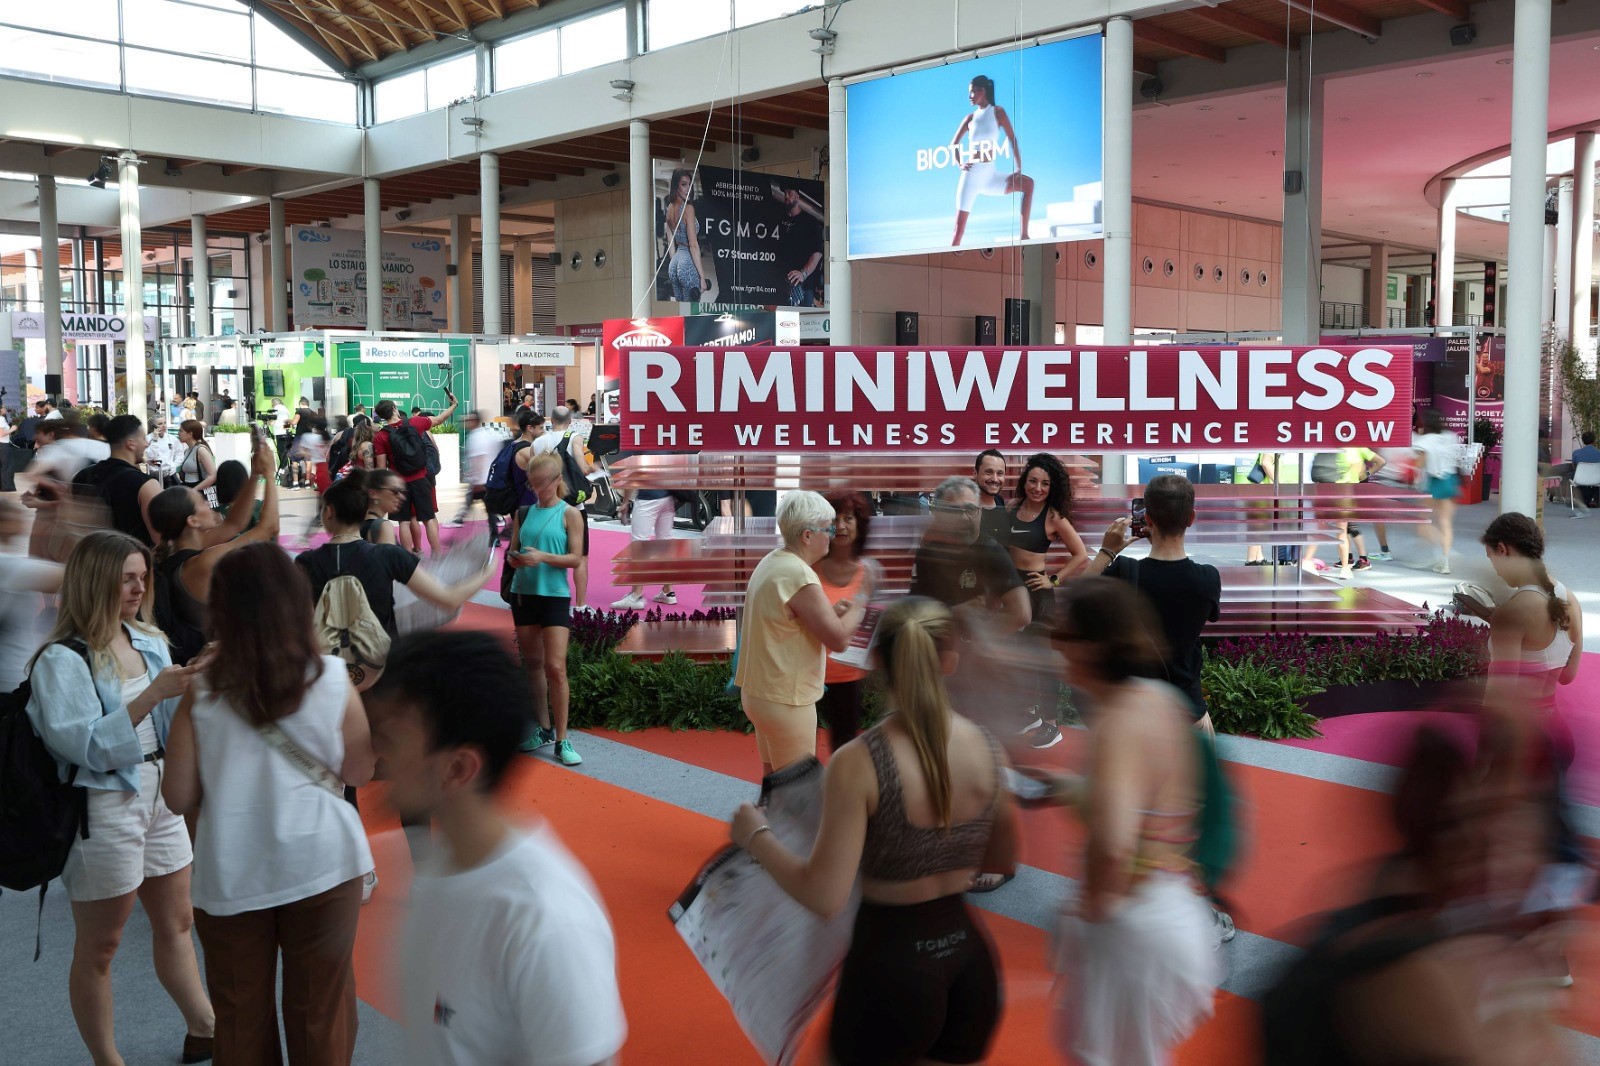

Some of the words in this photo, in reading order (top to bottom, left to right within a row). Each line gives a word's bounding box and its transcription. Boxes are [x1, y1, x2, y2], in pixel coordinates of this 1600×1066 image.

[916, 139, 1010, 171] BIOTHERM
[705, 217, 780, 240] FGM04
[717, 248, 730, 259] C7
[730, 249, 758, 261] Stand
[759, 251, 776, 262] 200
[329, 259, 340, 269] LO
[341, 260, 358, 271] STAI
[381, 263, 414, 274] MANDO
[61, 316, 125, 333] MANDO
[371, 347, 398, 357] Resto
[411, 348, 445, 358] Carlino
[628, 348, 1396, 412] RIMINIWELLNESS
[1474, 409, 1504, 417] OCIETÀ
[629, 424, 704, 446] THE
[733, 423, 956, 446] WELLNESS
[985, 421, 1249, 445] EXPERIENCE
[1276, 420, 1395, 444] SHOW
